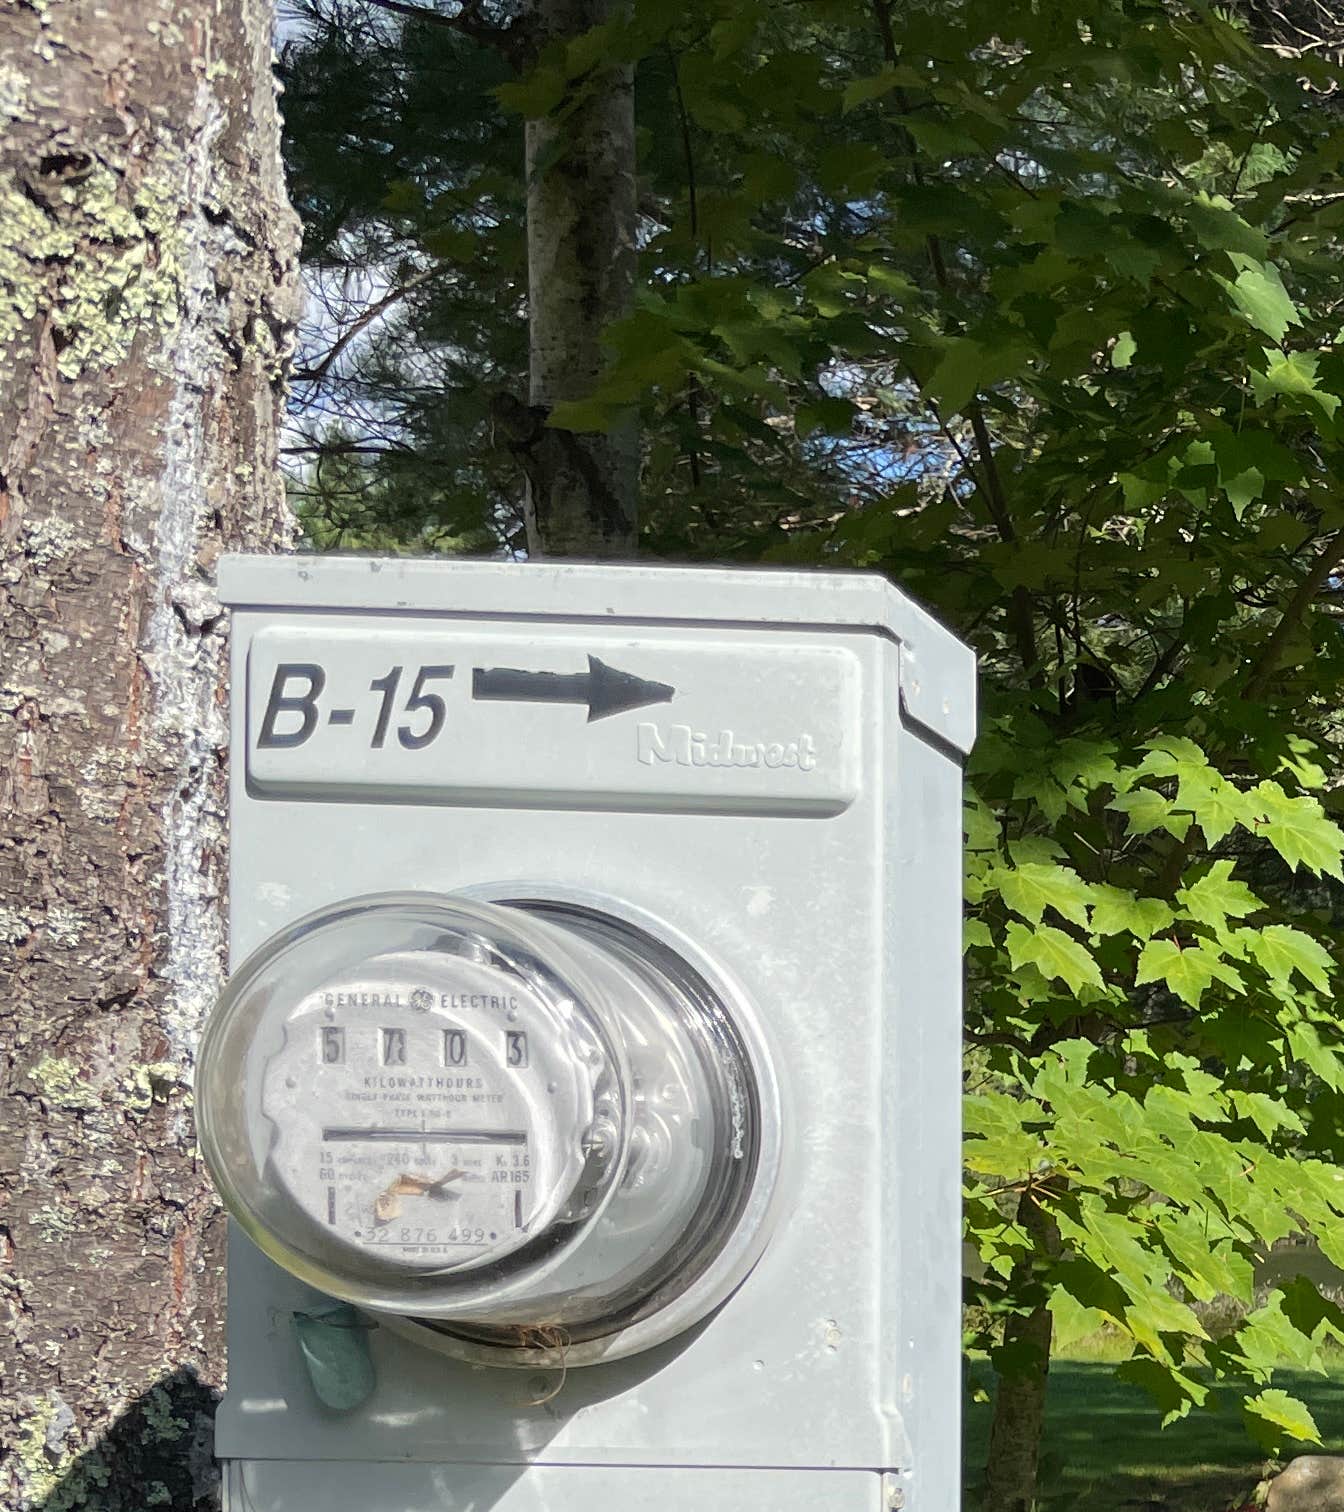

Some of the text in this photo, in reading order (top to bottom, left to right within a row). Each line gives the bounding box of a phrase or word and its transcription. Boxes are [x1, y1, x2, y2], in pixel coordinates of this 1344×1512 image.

[256, 663, 454, 750] B-15
[637, 722, 818, 771] Midwest
[324, 992, 519, 1010] GENERAL ELECTRIC
[364, 1076, 484, 1089] KILOWATTHOURS
[400, 1228, 438, 1243] 876
